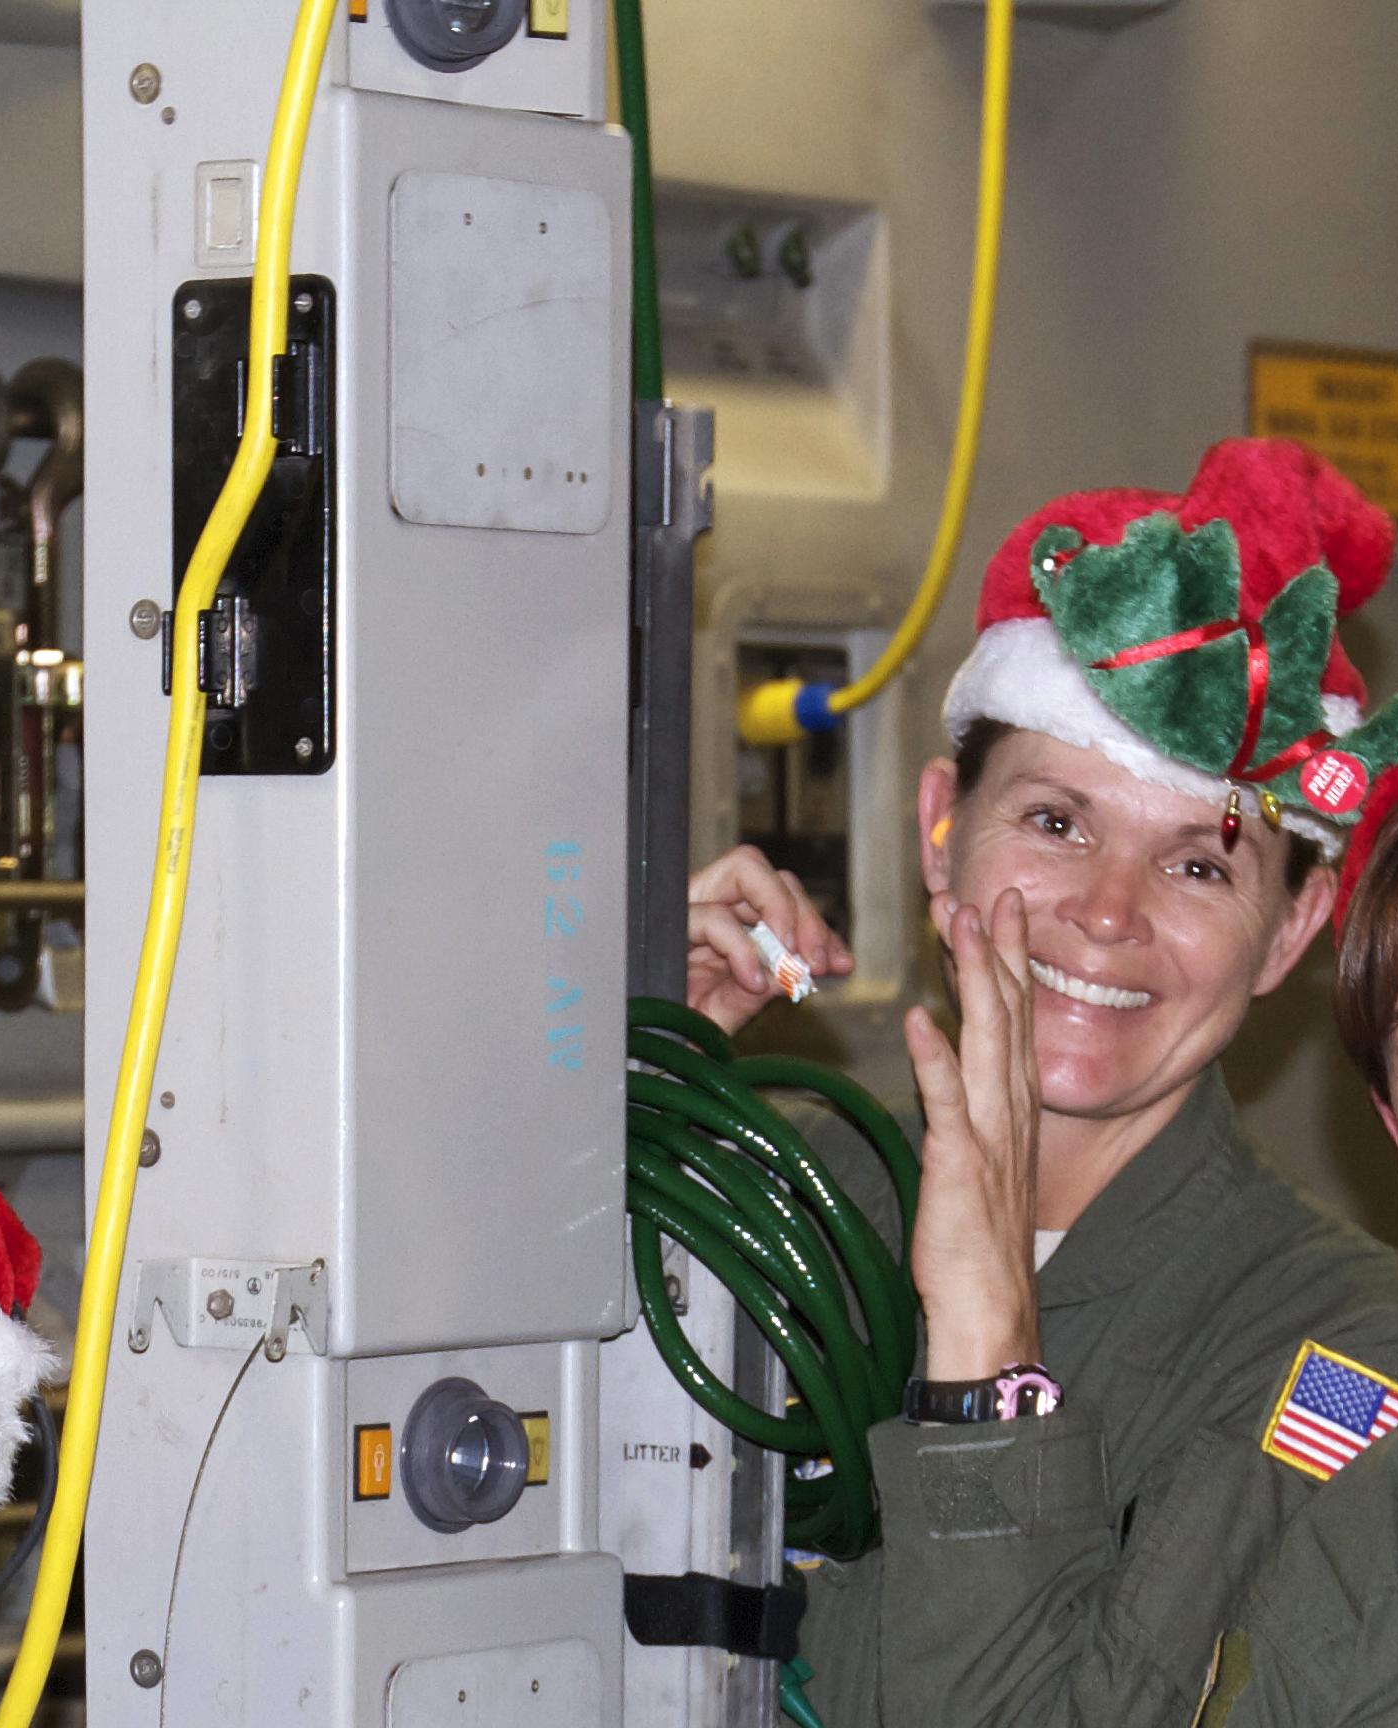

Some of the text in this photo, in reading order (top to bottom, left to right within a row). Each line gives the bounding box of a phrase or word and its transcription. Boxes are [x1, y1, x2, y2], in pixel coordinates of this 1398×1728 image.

[1308, 756, 1340, 796] PRESS
[1324, 765, 1355, 806] HERE!
[623, 1442, 681, 1463] LITTER
